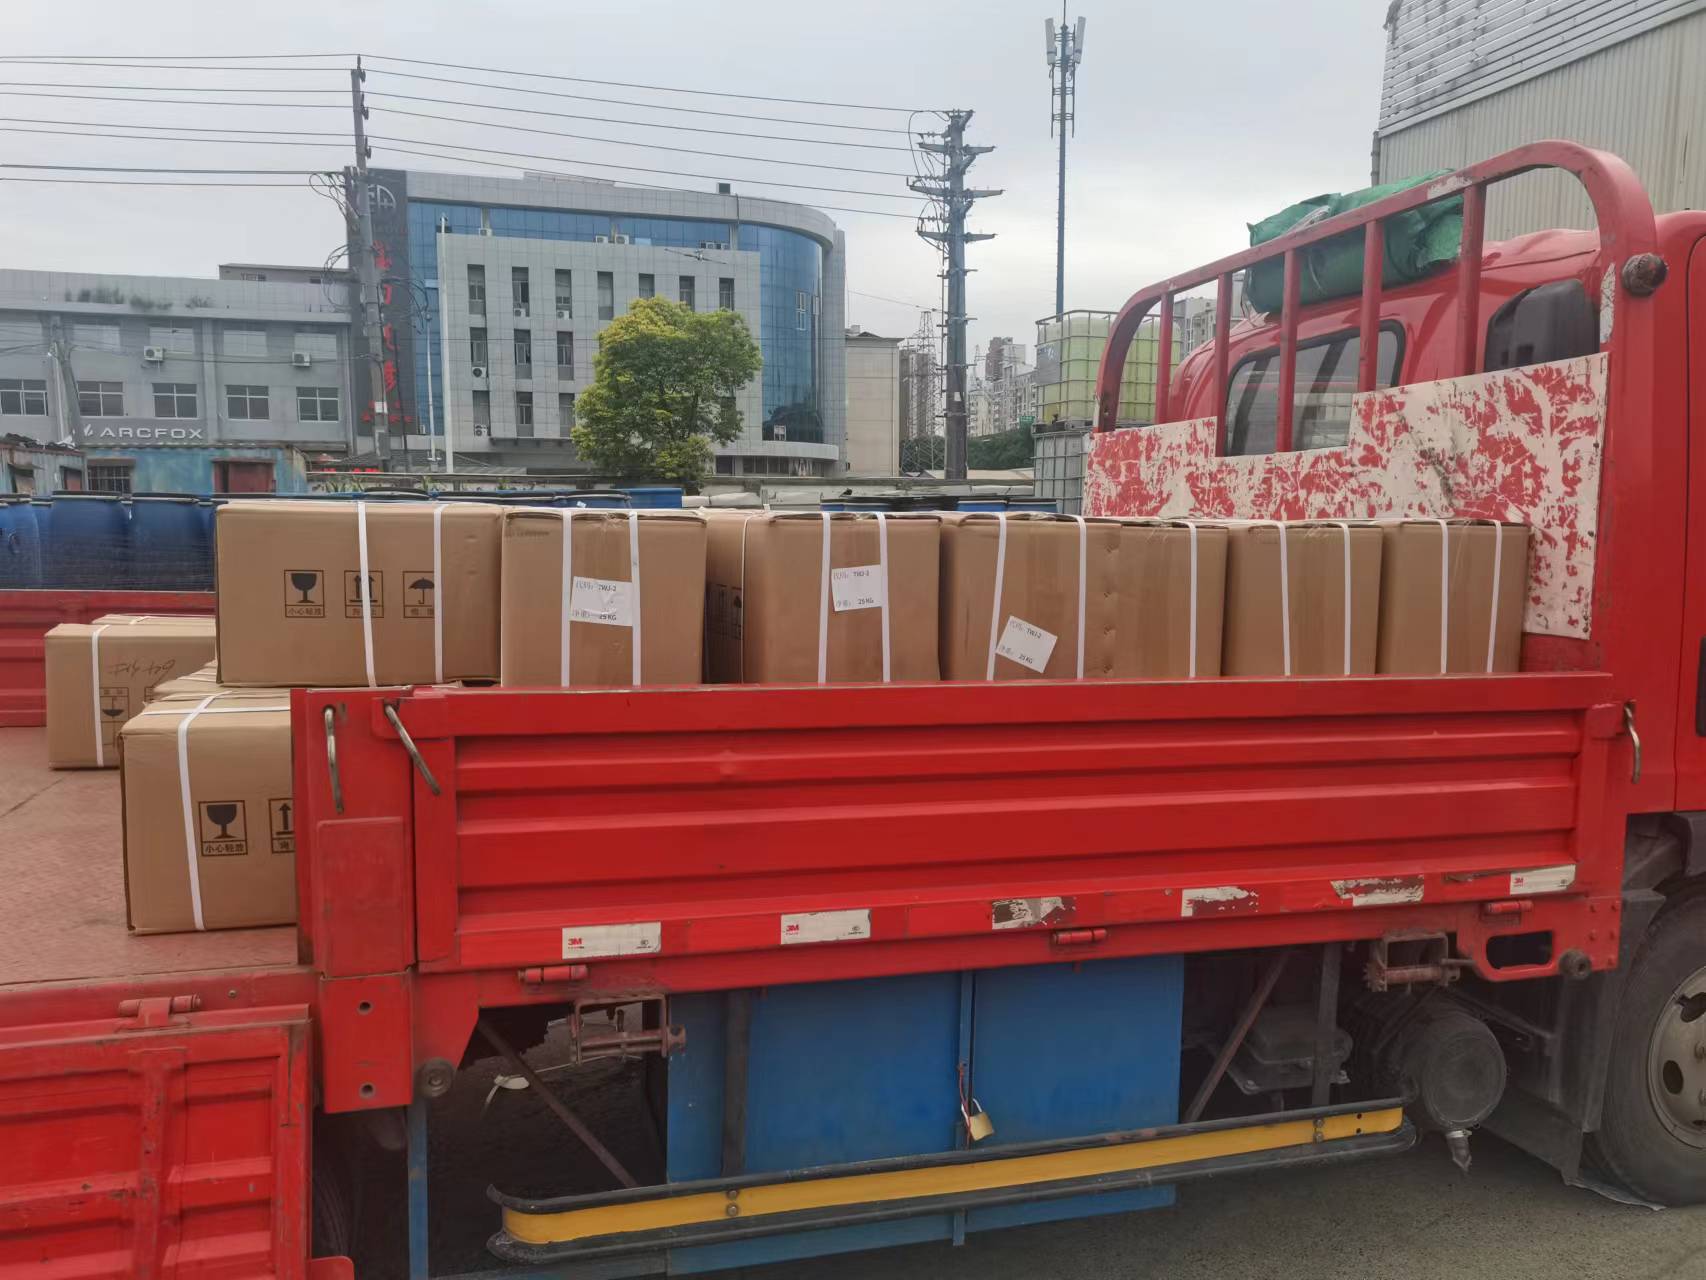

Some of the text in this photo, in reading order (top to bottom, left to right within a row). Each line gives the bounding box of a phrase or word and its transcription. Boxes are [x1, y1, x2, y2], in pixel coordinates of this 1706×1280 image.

[100, 427, 203, 439] ARCFOX
[205, 843, 245, 854] 小心轻放
[786, 924, 799, 932] 3M
[568, 938, 583, 946] 3M
